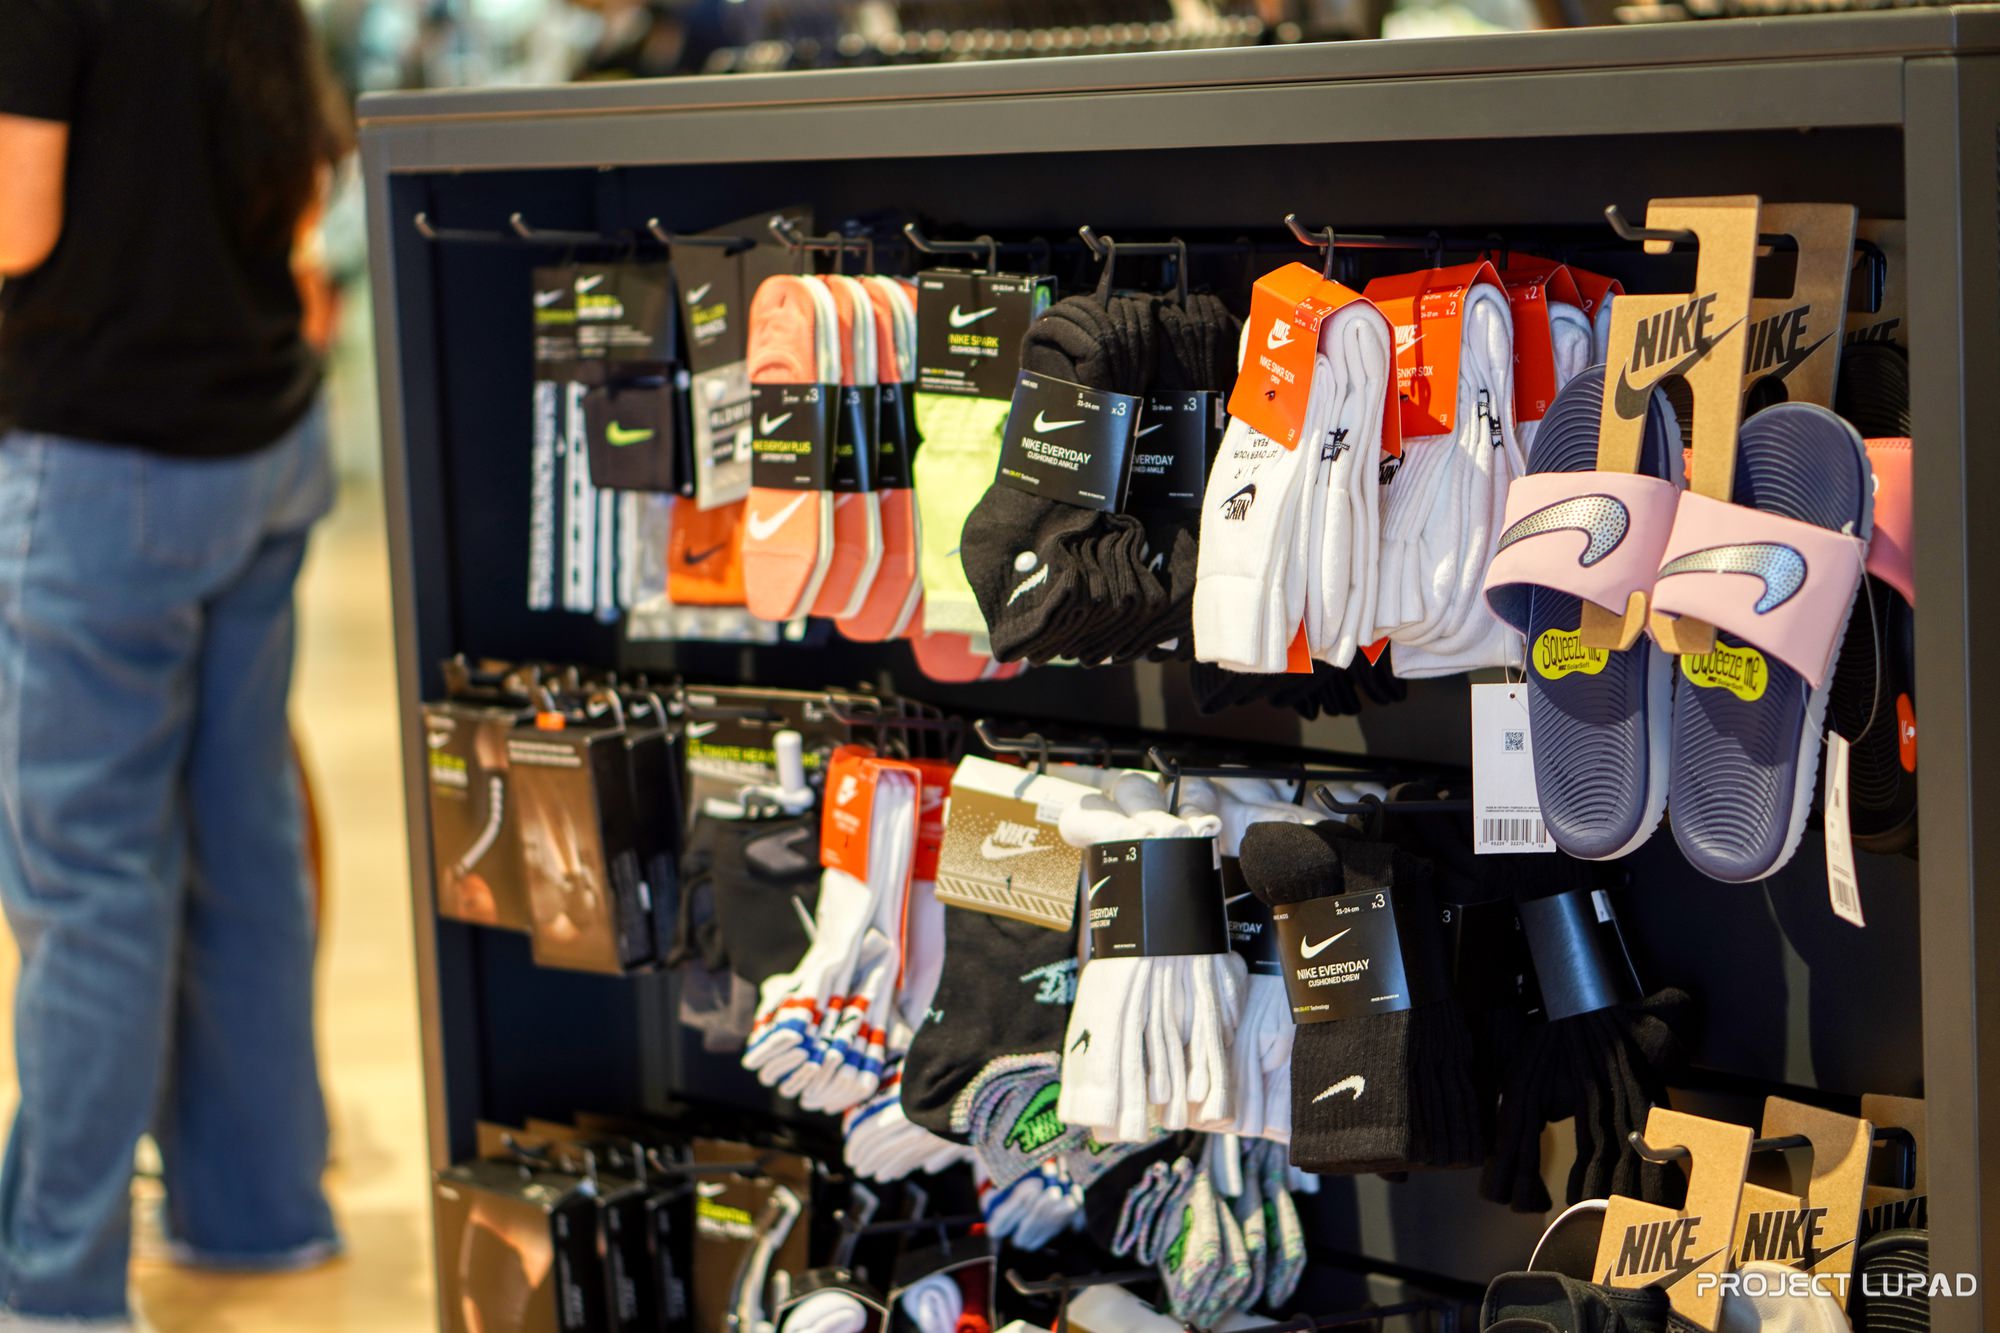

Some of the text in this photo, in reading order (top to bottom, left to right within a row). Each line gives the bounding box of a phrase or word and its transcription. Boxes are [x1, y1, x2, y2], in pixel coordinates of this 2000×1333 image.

[1583, 299, 1593, 312] 2
[950, 334, 998, 347] NIKE SPARK
[1631, 292, 1717, 374] NIKE
[1418, 366, 1433, 377] SOX
[1111, 402, 1127, 416] x3
[1183, 397, 1197, 412] x3
[1022, 437, 1092, 465] NIKE EVERYDAY
[1027, 451, 1080, 471] CUSHIONED ANKLE
[1224, 498, 1250, 521] NIKE
[992, 820, 1041, 847] NIKE
[1125, 847, 1137, 861] x3
[1371, 893, 1386, 909] x3
[1442, 910, 1451, 923] 3
[1228, 921, 1263, 933] ERYDAY
[1297, 959, 1370, 980] NIKE EVERYDAY
[1308, 973, 1360, 988] CUSHIONED CREW
[1741, 1208, 1829, 1264] NIKE
[1616, 1216, 1702, 1277] NIKE
